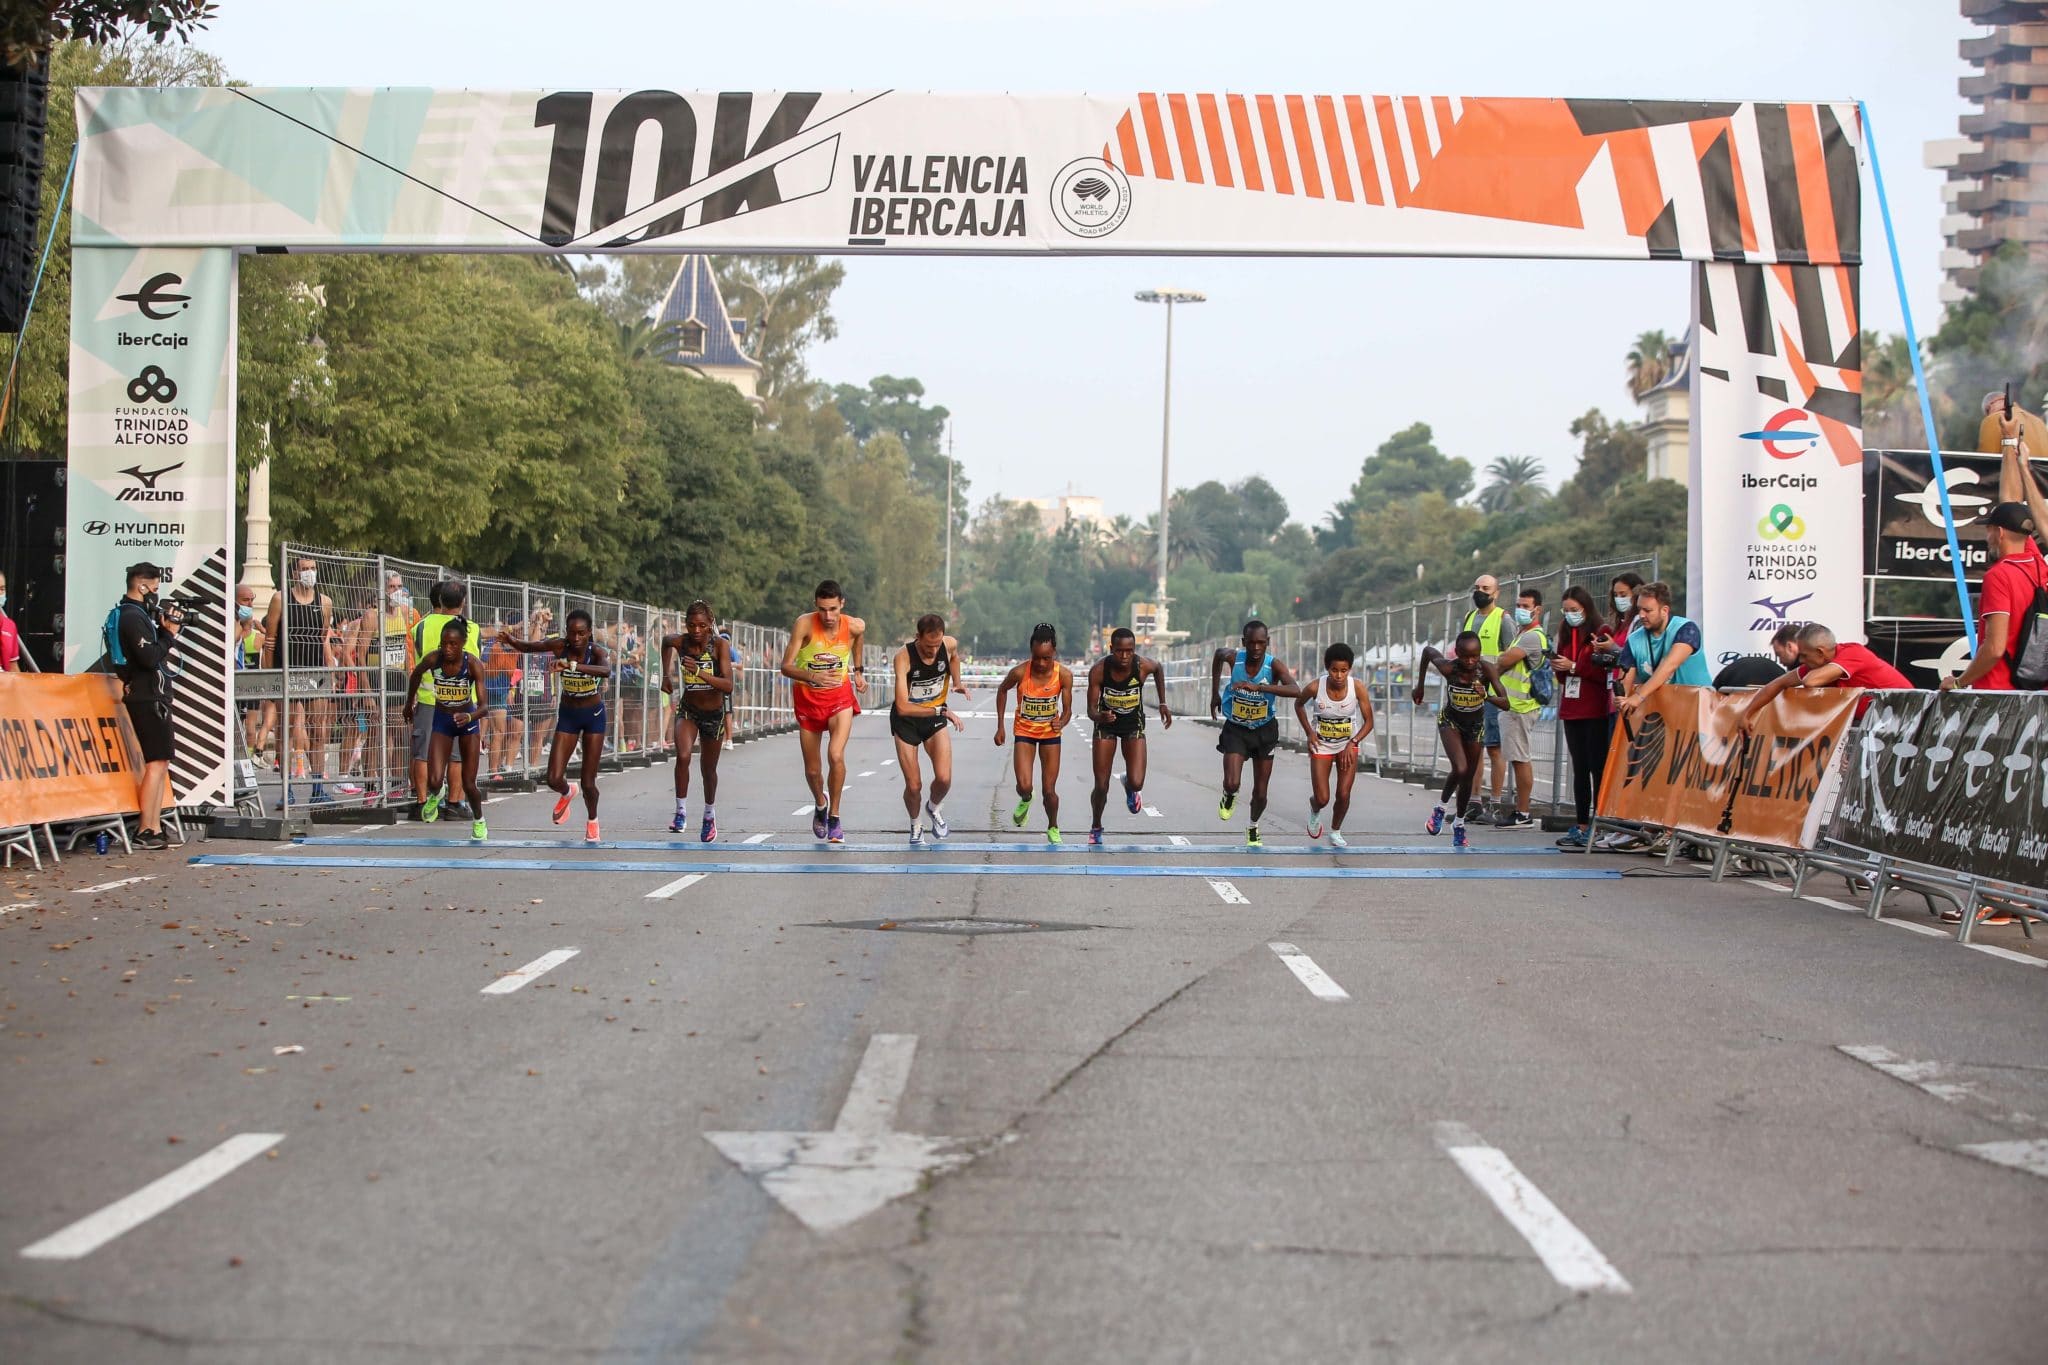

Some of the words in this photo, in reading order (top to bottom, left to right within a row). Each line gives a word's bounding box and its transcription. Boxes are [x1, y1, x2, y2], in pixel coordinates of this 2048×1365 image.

[534, 90, 822, 247] 10K
[853, 155, 1028, 194] VALENCIA
[849, 197, 1027, 237] IBERCAJA
[117, 332, 188, 350] iberCaja
[115, 407, 188, 416] FUNDACIÓN
[115, 418, 188, 431] TRINIDAD
[115, 433, 188, 445] ALFONSO
[1742, 473, 1817, 491] iberCaja
[115, 523, 185, 534] HYUNDAI
[115, 538, 152, 547] Autiber
[154, 538, 184, 547] Motor
[1747, 544, 1817, 552] FUNDACIÓN
[1747, 555, 1817, 567] TRINIDAD
[1747, 569, 1817, 580] ALFONSO
[437, 687, 468, 696] JERUTO
[1025, 703, 1056, 712] CHEBET
[1240, 705, 1262, 715] PACE
